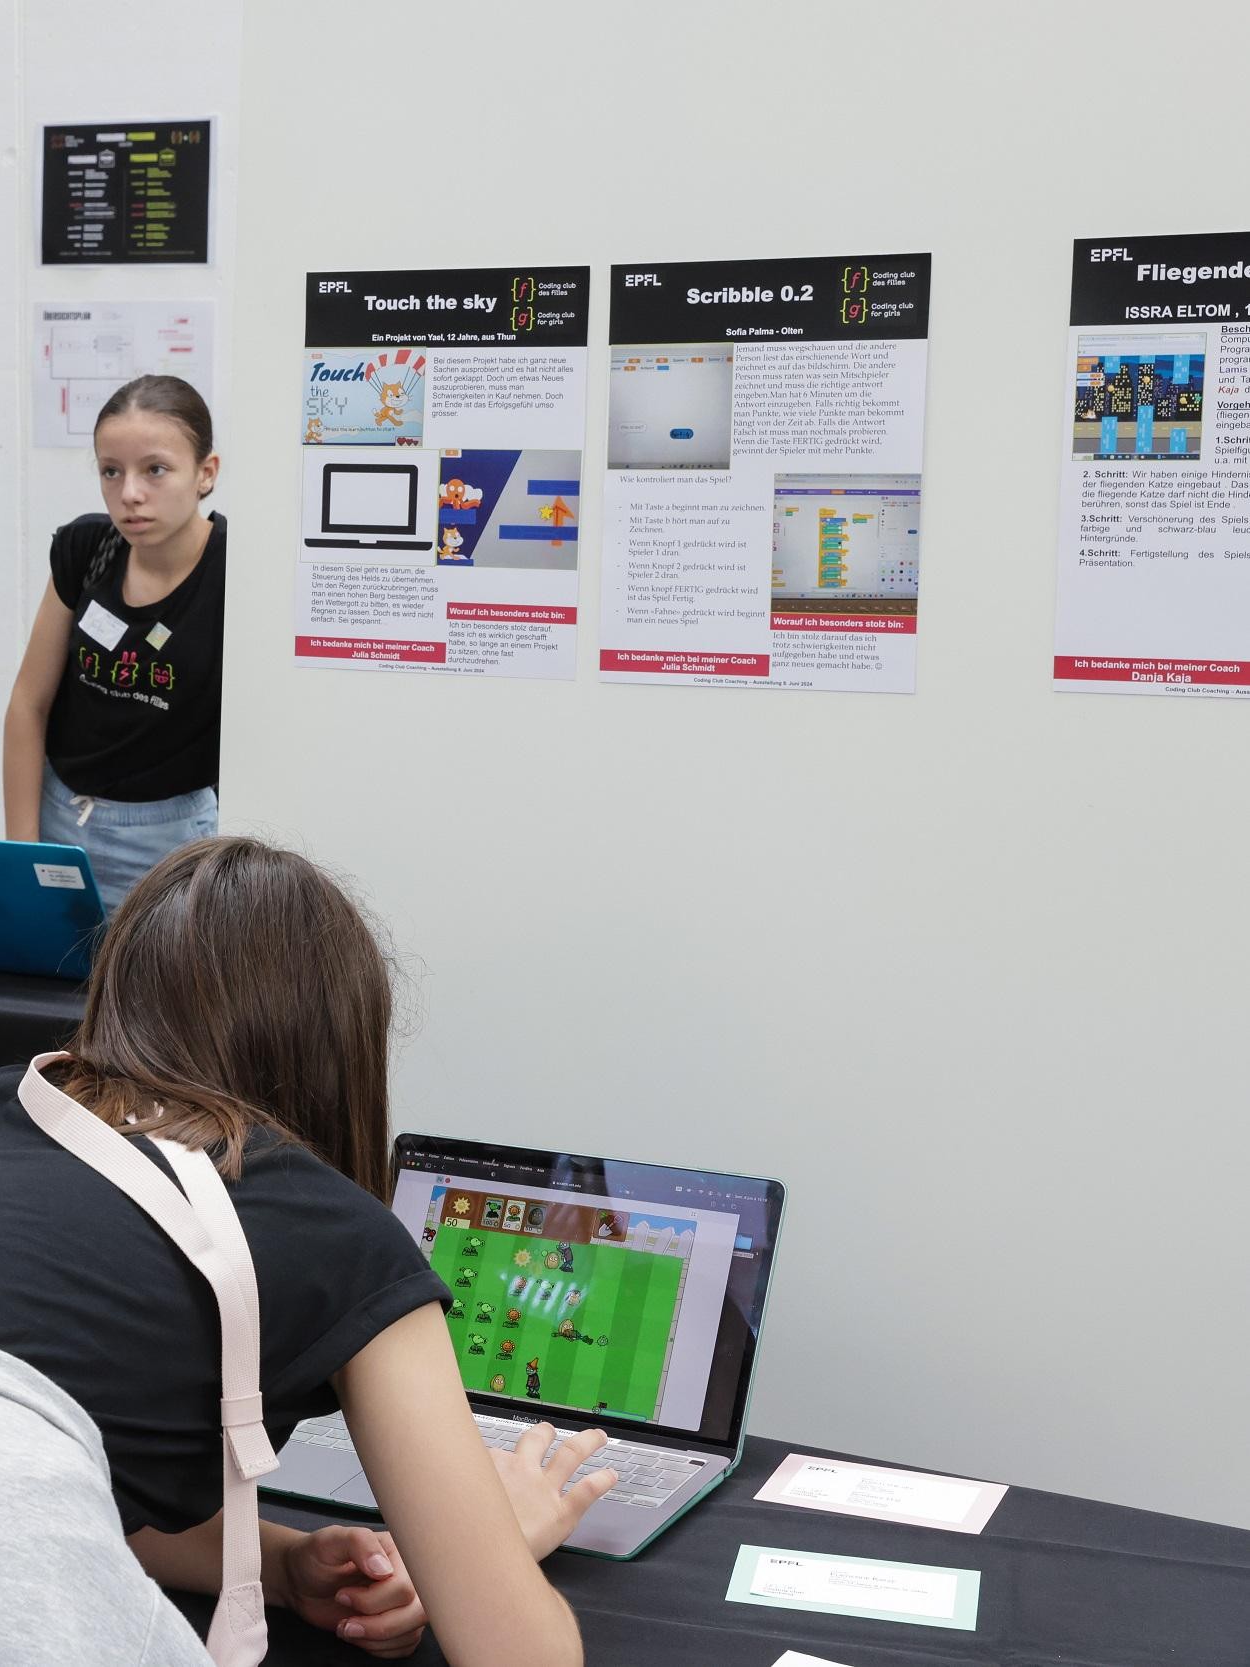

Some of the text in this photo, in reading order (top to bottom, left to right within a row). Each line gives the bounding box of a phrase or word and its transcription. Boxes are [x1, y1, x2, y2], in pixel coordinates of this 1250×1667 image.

[1090, 248, 1132, 261] EPFL
[625, 274, 661, 286] EPFL
[872, 272, 898, 281] Coding
[319, 281, 351, 292] EPFL
[538, 282, 560, 291] Coding
[686, 285, 813, 303] Scribble 0.2
[364, 294, 496, 312] Touch the sky
[871, 303, 896, 312] Coding
[537, 312, 560, 320] Coding
[884, 309, 900, 318] girls
[1125, 305, 1172, 318] ISSRA
[1177, 304, 1230, 317] ELTOM
[726, 328, 746, 336] Sofia
[749, 327, 773, 336] Palma
[781, 327, 803, 335] Olten
[372, 334, 383, 342] Ein
[385, 334, 410, 343] Projekt
[428, 333, 444, 342] Yael,
[447, 333, 455, 341] 12
[457, 333, 479, 342] Jahre,
[496, 333, 516, 341] Thun
[434, 357, 444, 365] Bei
[473, 356, 496, 366] Projekt
[530, 358, 546, 366] ganz
[310, 362, 364, 381] Touch
[311, 386, 329, 397] the
[307, 397, 348, 415] SKY
[695, 476, 707, 484] das
[709, 475, 731, 485] Spiel?
[1150, 471, 1177, 479] haben
[1181, 472, 1207, 480] einige
[1151, 500, 1166, 508] das
[1169, 500, 1191, 510] Spiel
[1194, 500, 1204, 509] ist
[1207, 500, 1230, 509] Ende
[1081, 514, 1122, 523] 3.Schritt:
[1200, 516, 1215, 524] des
[1221, 516, 1248, 525] Spiels
[1080, 534, 1138, 544] Hintergründe.
[1079, 549, 1214, 560] 4.Schritt: Fertigstellung des
[1079, 559, 1135, 567] Präsentation.
[449, 607, 564, 619] Worauf ich besonders stolz bin:
[773, 617, 903, 629] Worauf ich besonders stolz bin:
[787, 632, 799, 640] bin
[821, 633, 847, 641] darauf
[848, 634, 862, 642] das
[865, 634, 876, 642] ich
[310, 639, 321, 647] Ich
[322, 640, 352, 648] bedanke
[372, 642, 383, 650] bei
[385, 643, 410, 651] meiner
[411, 644, 434, 652] Coach
[352, 651, 399, 661] Julia Schmidt
[617, 653, 756, 665] Ich bedanke mich bei meiner Coach
[661, 663, 714, 672] Julia Schmidt
[1075, 659, 1239, 673] Ich bedanke mich bei meiner Coach
[1132, 672, 1191, 683] Danja Kaja
[446, 1218, 457, 1226] 50
[513, 1415, 538, 1424] MacBook
